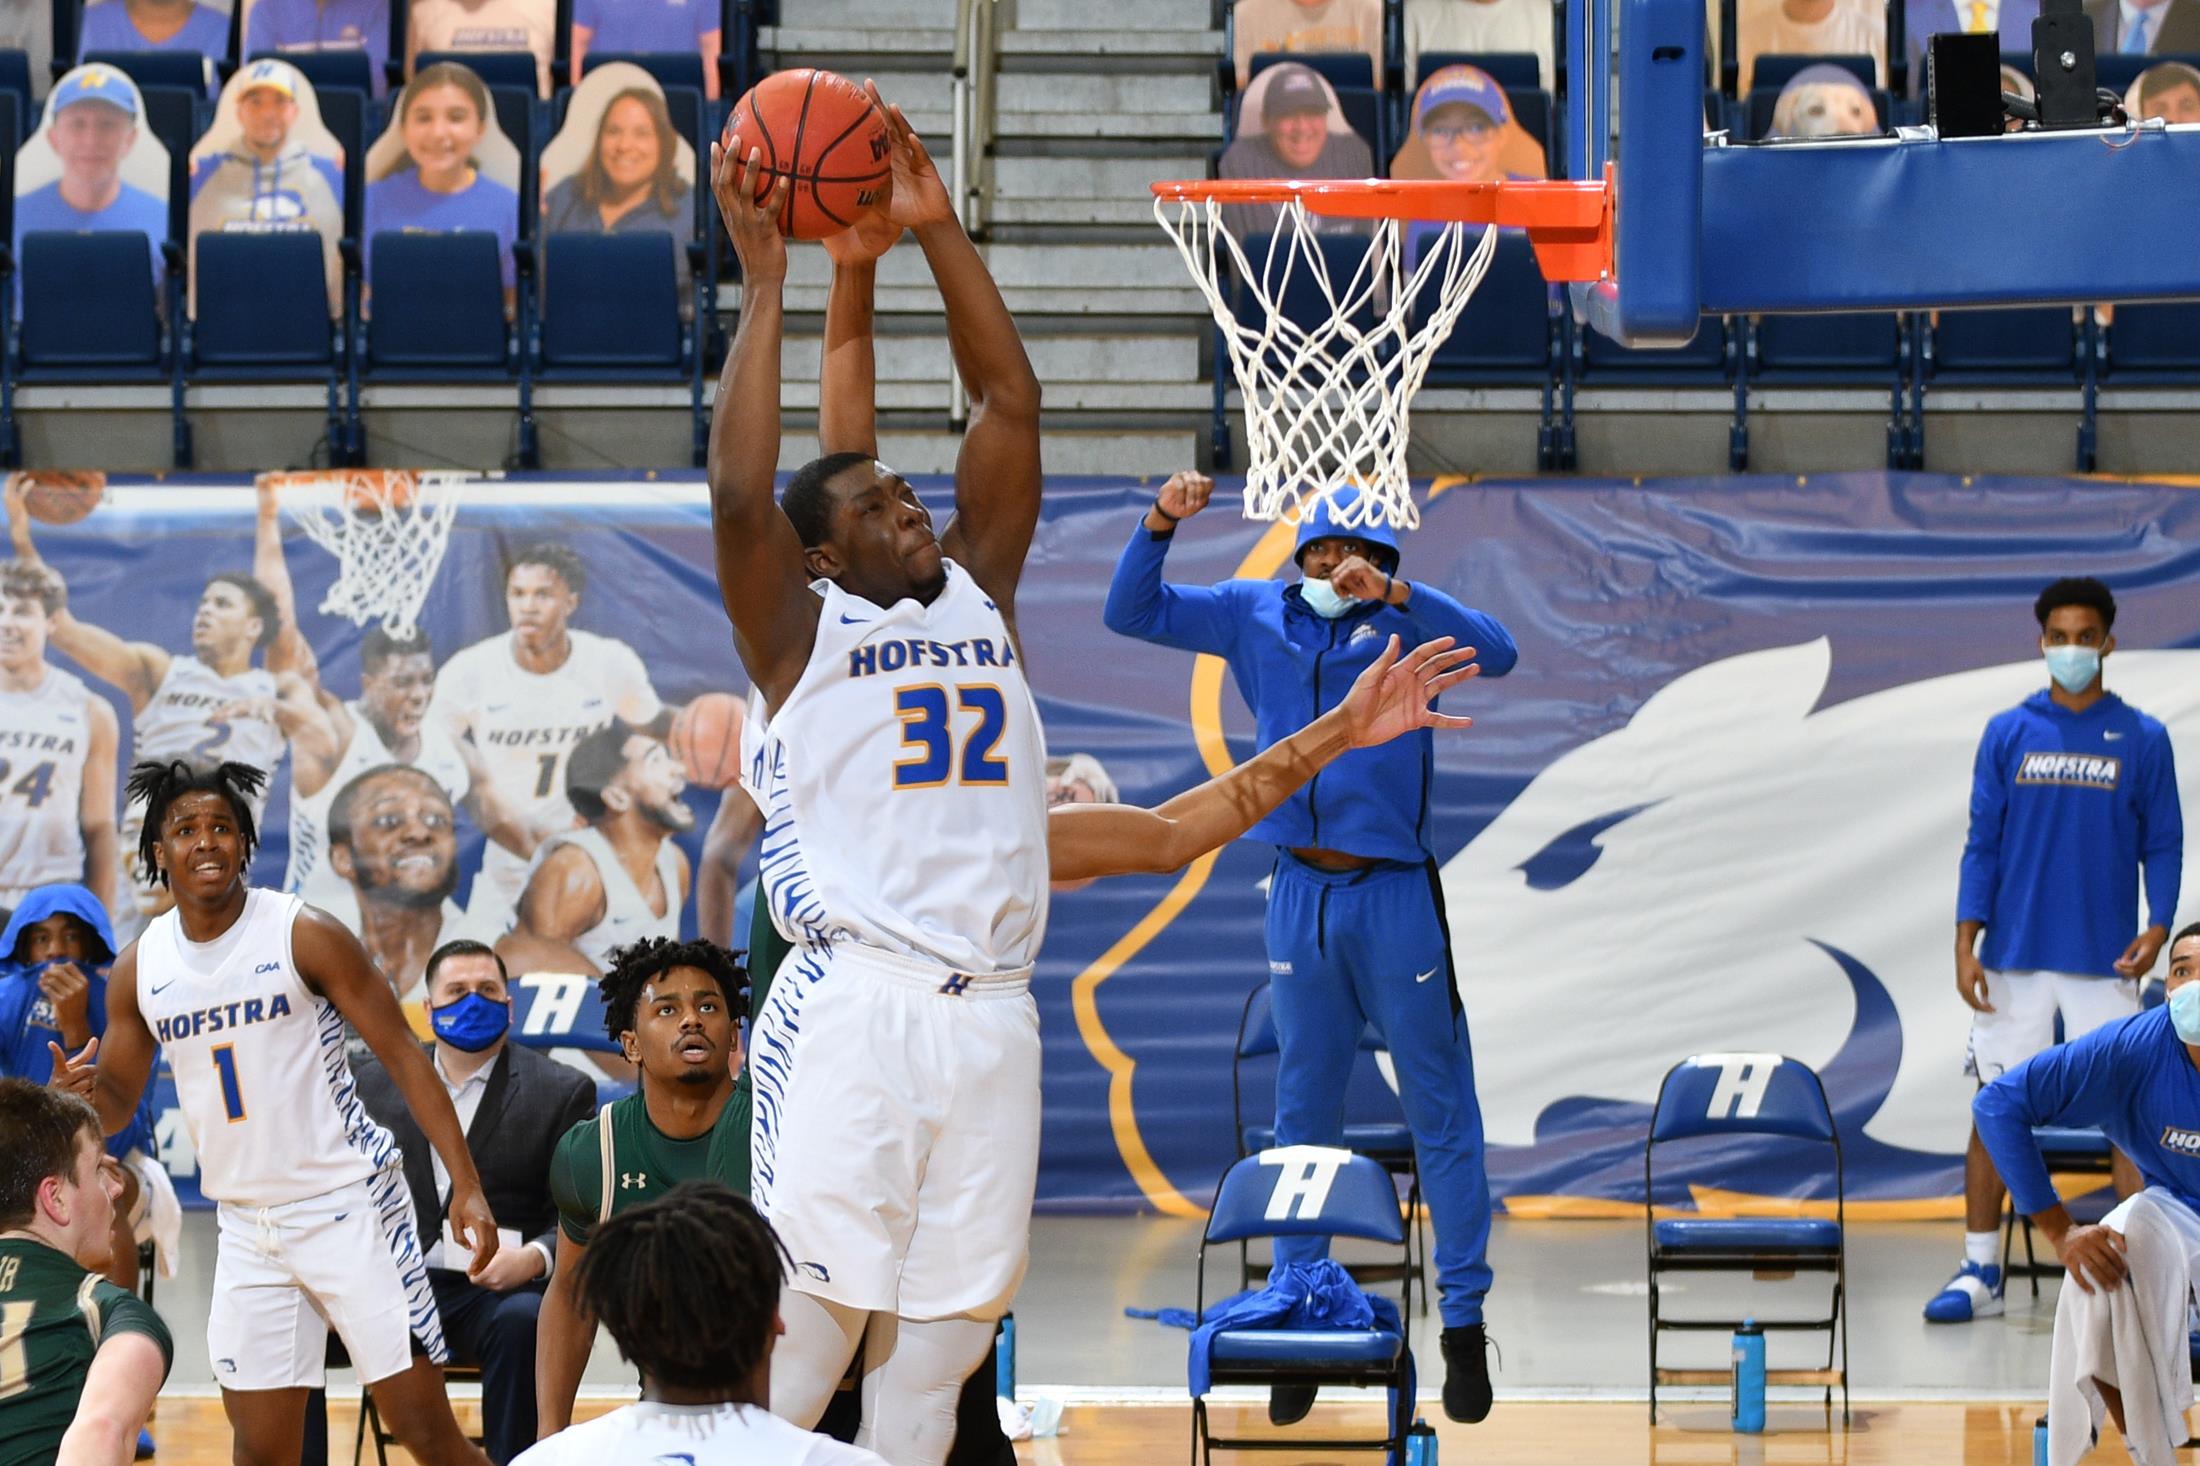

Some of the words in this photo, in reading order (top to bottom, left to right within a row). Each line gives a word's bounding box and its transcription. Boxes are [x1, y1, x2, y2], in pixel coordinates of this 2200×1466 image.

[488, 722, 604, 746] HOFSTR
[892, 682, 1009, 791] 32
[534, 752, 559, 799] 1
[2024, 755, 2117, 780] HOFSTRA
[255, 961, 280, 975] CAA
[155, 992, 292, 1044] HOFSTRA
[210, 1041, 247, 1124] 1
